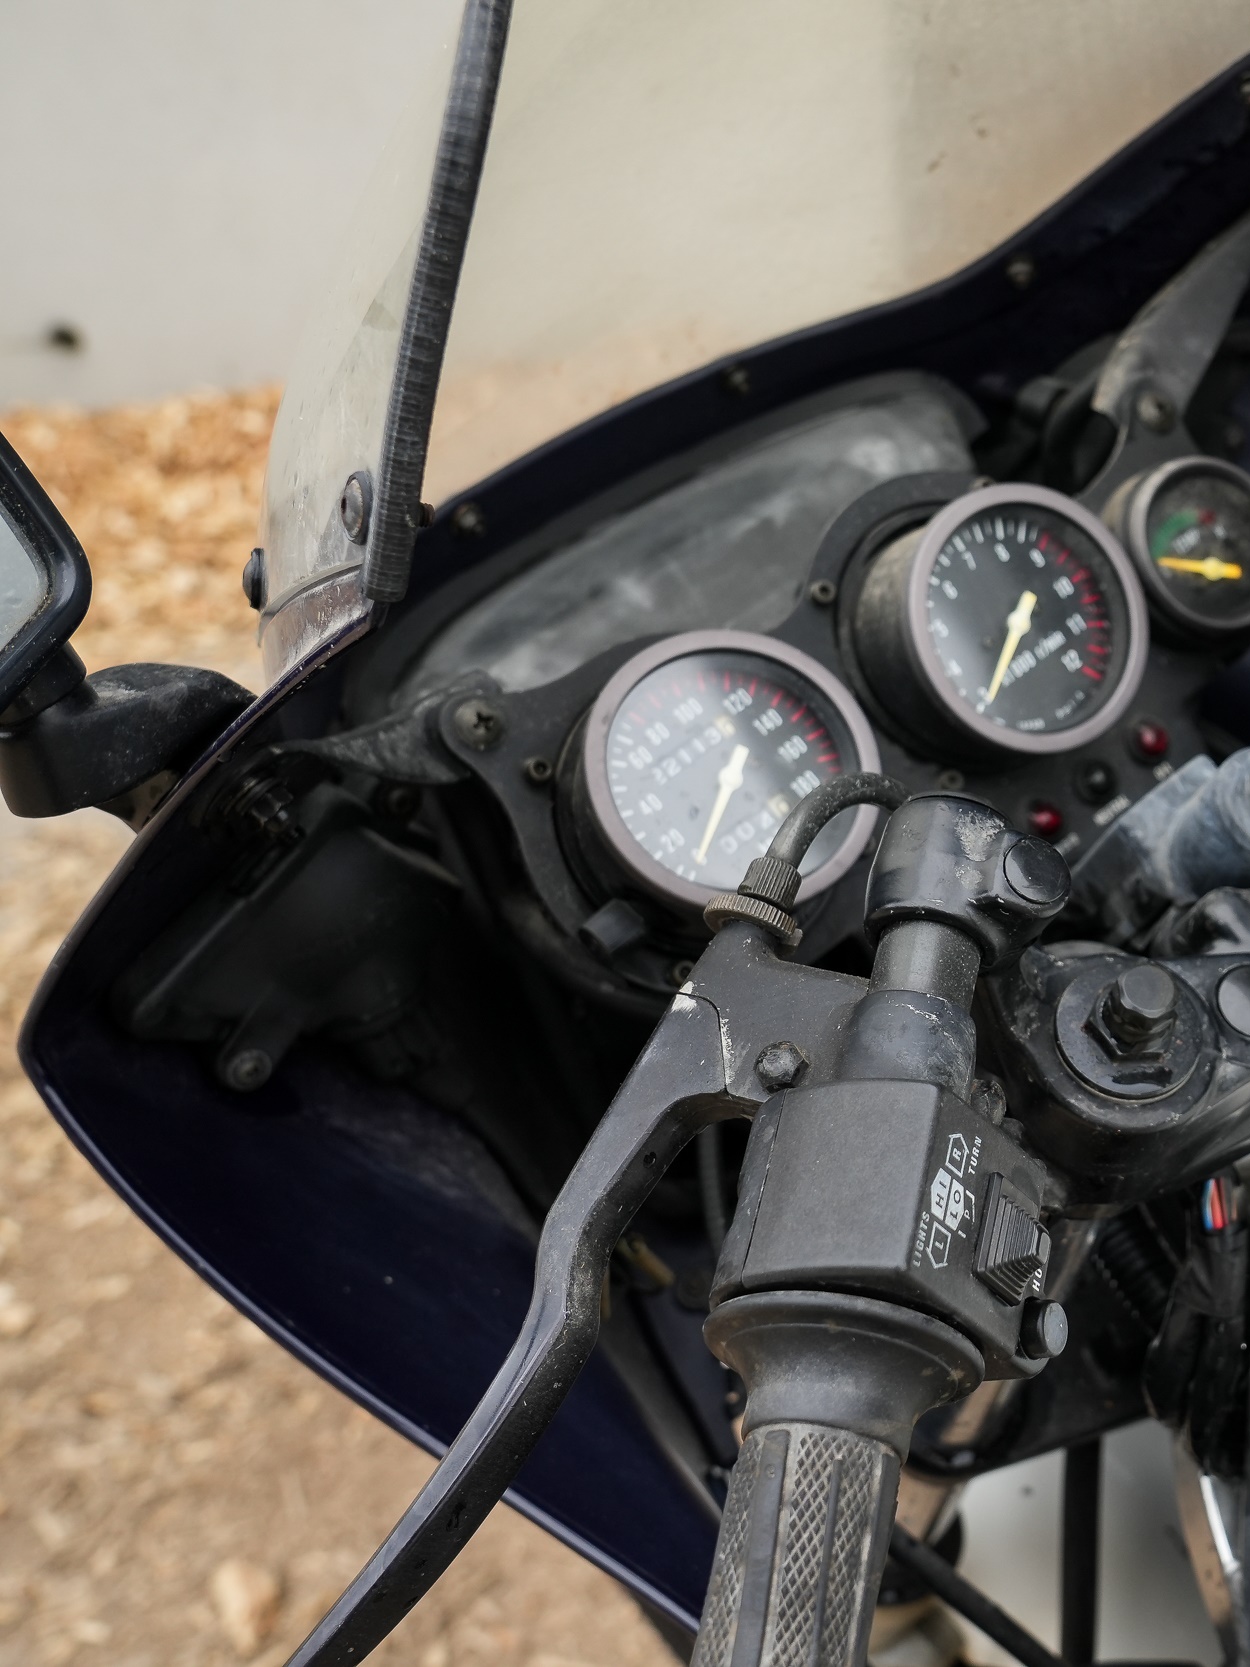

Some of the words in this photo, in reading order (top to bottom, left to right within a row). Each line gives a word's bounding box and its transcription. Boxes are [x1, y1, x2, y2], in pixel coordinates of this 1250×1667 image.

[673, 697, 703, 725] 100
[723, 687, 752, 715] 120
[645, 722, 670, 746] 80
[753, 708, 783, 736] 140
[627, 745, 653, 770] 60
[777, 735, 808, 763] 160
[790, 769, 821, 799] 180
[639, 793, 663, 815] 40
[660, 828, 685, 853] 20
[952, 1147, 962, 1162] R
[968, 1136, 982, 1175] TURN
[935, 1180, 948, 1209] HI
[949, 1190, 962, 1220] LO
[912, 1211, 931, 1267] LIGHTS
[934, 1241, 945, 1250] L
